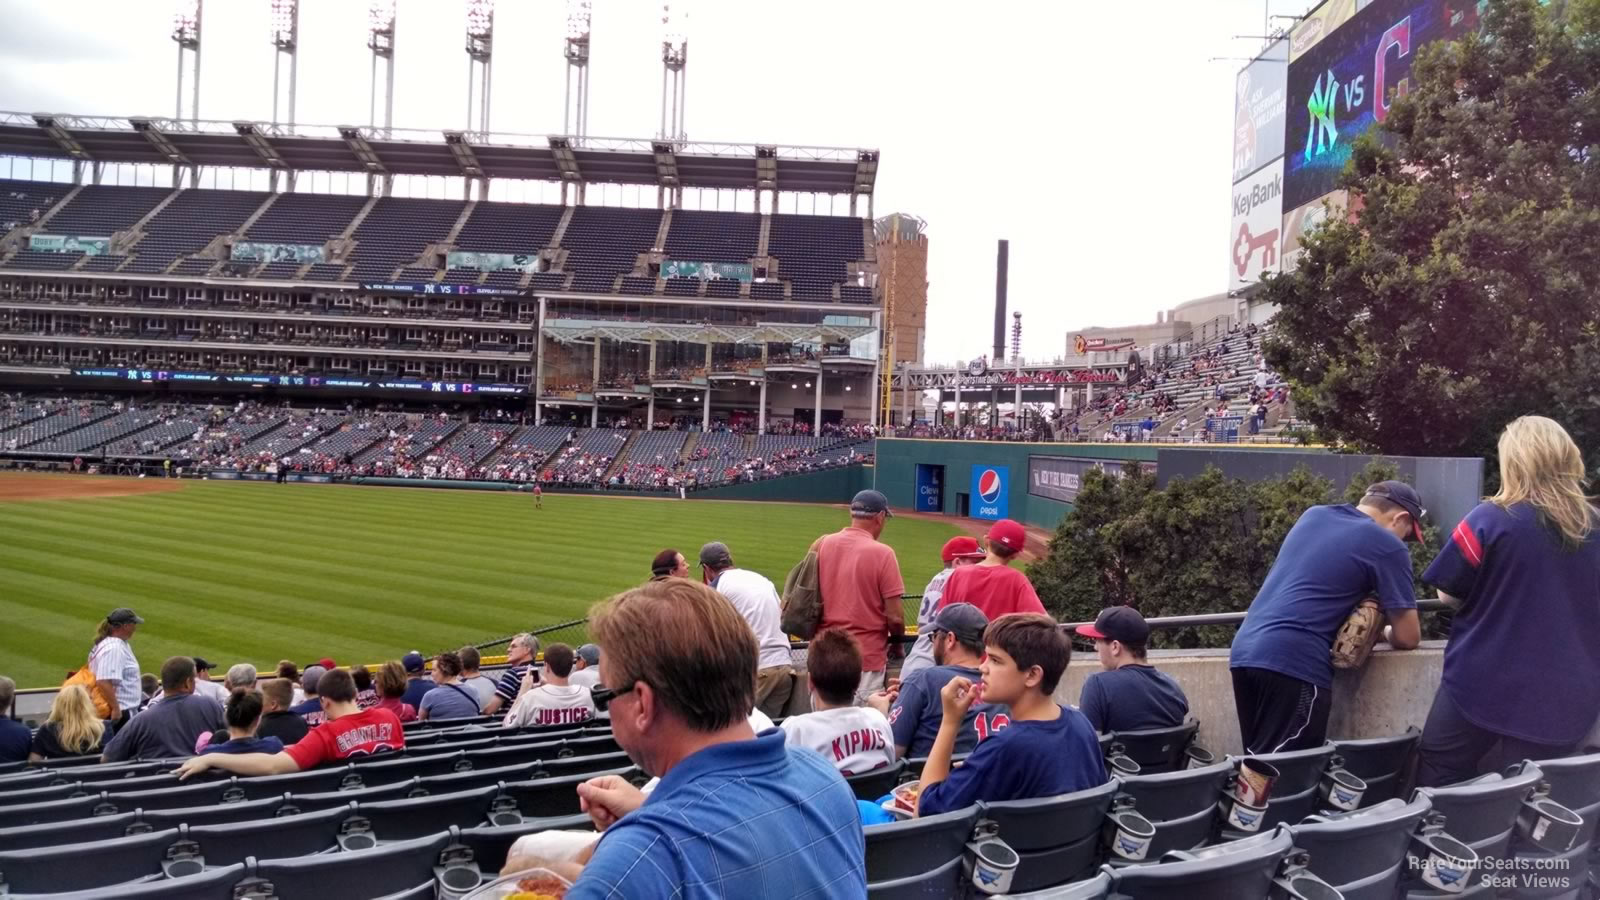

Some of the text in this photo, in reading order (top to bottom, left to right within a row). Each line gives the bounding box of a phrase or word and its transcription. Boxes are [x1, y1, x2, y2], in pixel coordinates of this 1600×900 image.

[1344, 74, 1365, 112] VS
[1233, 173, 1282, 217] KeyBank
[440, 285, 451, 294] VS
[141, 371, 152, 379] VS
[293, 377, 304, 385] VS
[1041, 470, 1049, 484] NEW
[1060, 472, 1079, 489] YANKEES
[980, 506, 998, 516] pepsi
[535, 707, 588, 725] JUSTICE
[335, 722, 393, 753] BRANTLEY
[832, 728, 886, 762] KIPNIS
